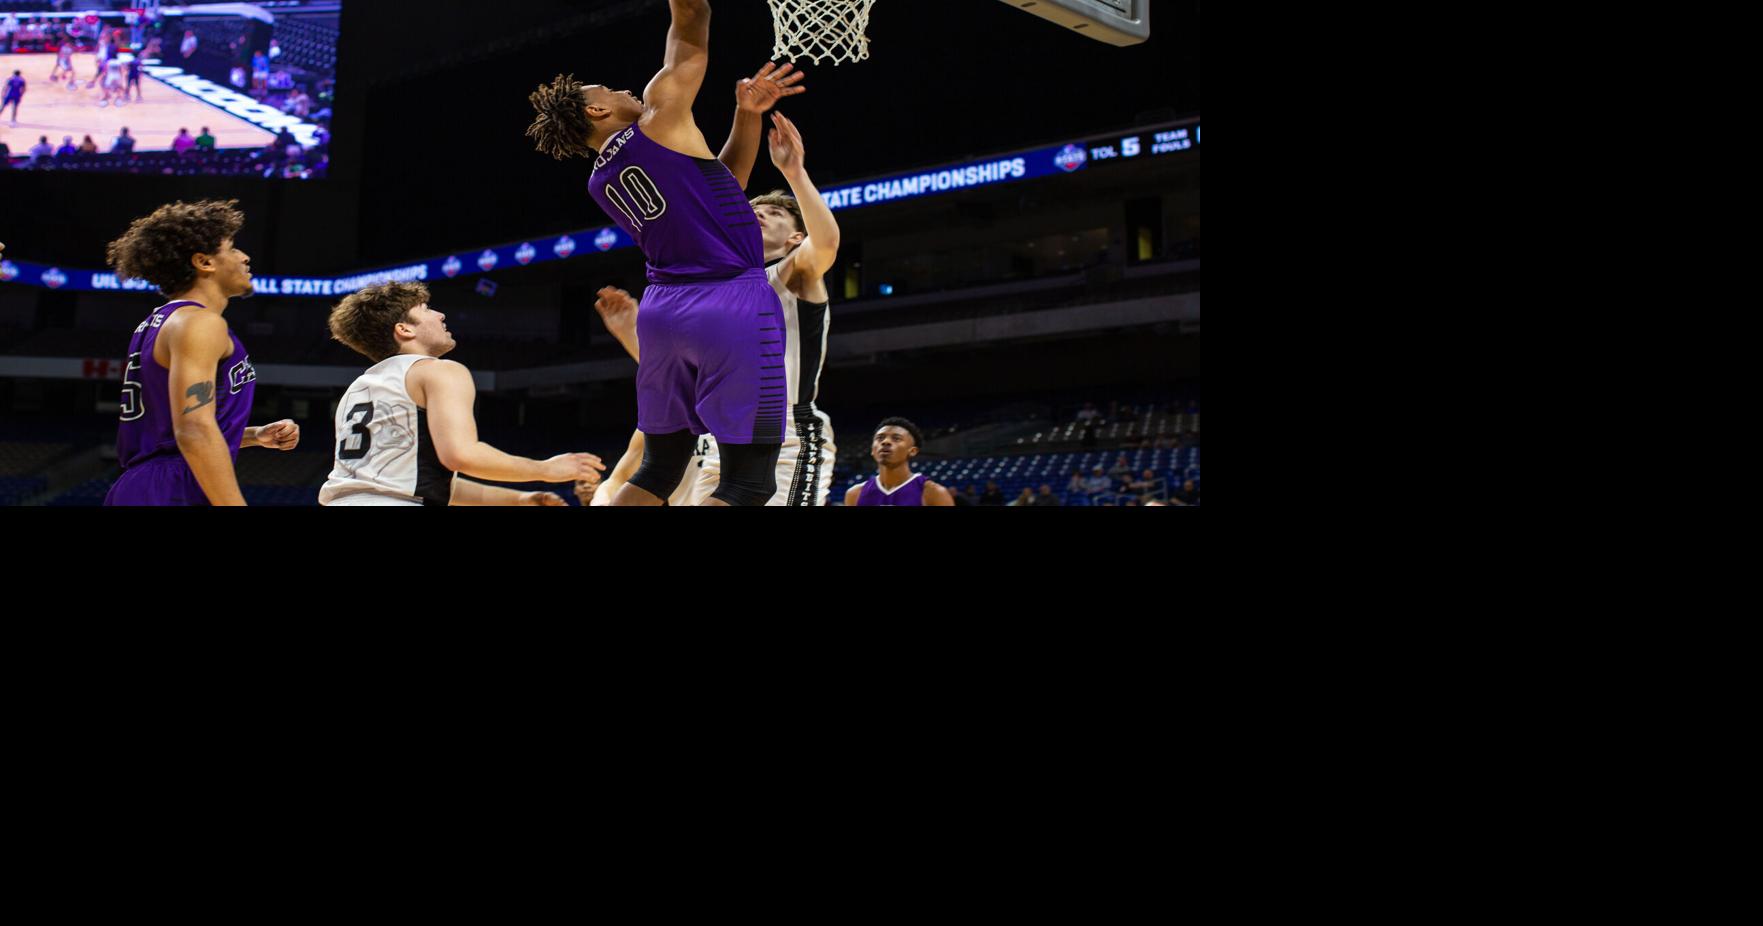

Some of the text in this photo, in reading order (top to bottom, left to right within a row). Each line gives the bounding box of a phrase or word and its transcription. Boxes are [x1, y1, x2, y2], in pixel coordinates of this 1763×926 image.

[1091, 146, 1118, 160] TOL
[1121, 137, 1140, 157] 5
[1152, 139, 1191, 154] FOULS
[1154, 129, 1188, 143] TEAM
[605, 166, 667, 232] 10
[820, 187, 862, 209] TATE
[863, 157, 1026, 203] CHAMPIONSHIPS
[92, 273, 119, 289] UIL
[281, 278, 333, 294] STATE
[119, 352, 145, 421] 5
[339, 400, 374, 460] 3
